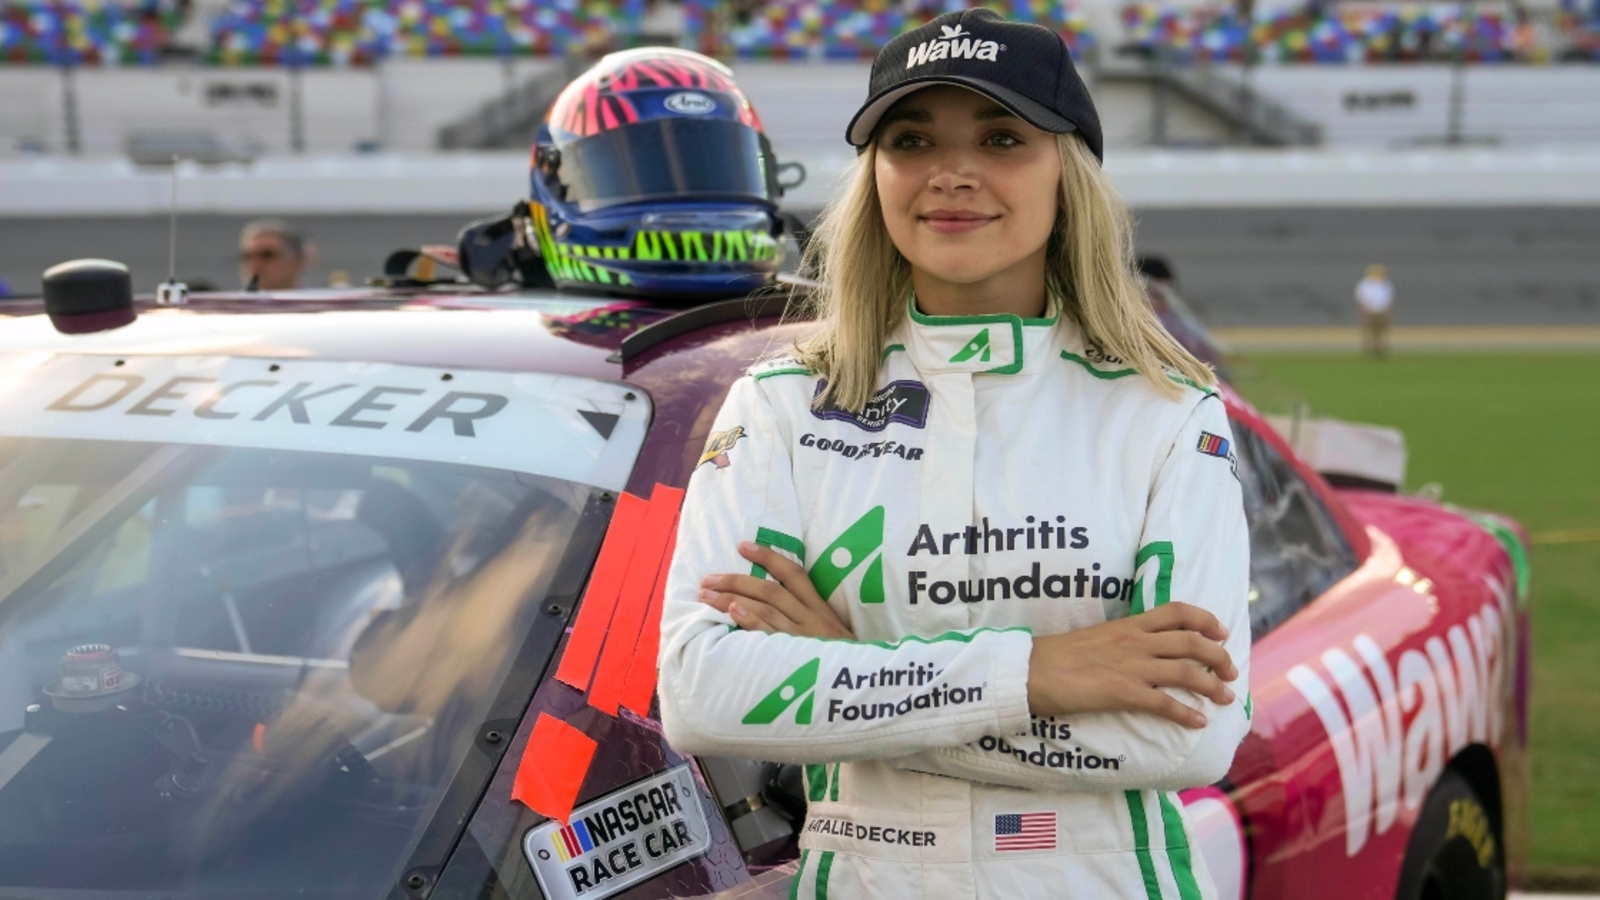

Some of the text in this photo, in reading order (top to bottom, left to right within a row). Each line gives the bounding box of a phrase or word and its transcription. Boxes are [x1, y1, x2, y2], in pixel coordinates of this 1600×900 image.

[45, 373, 509, 438] DECKER
[799, 433, 924, 461] GOODYEAR
[907, 515, 1090, 556] Arthritis
[908, 562, 1135, 605] Foundation
[828, 683, 983, 723] Foundation
[978, 734, 1120, 771] oundation
[584, 782, 683, 848] NASCAR
[569, 820, 693, 893] RACE CAR
[856, 825, 937, 847] DECKER
